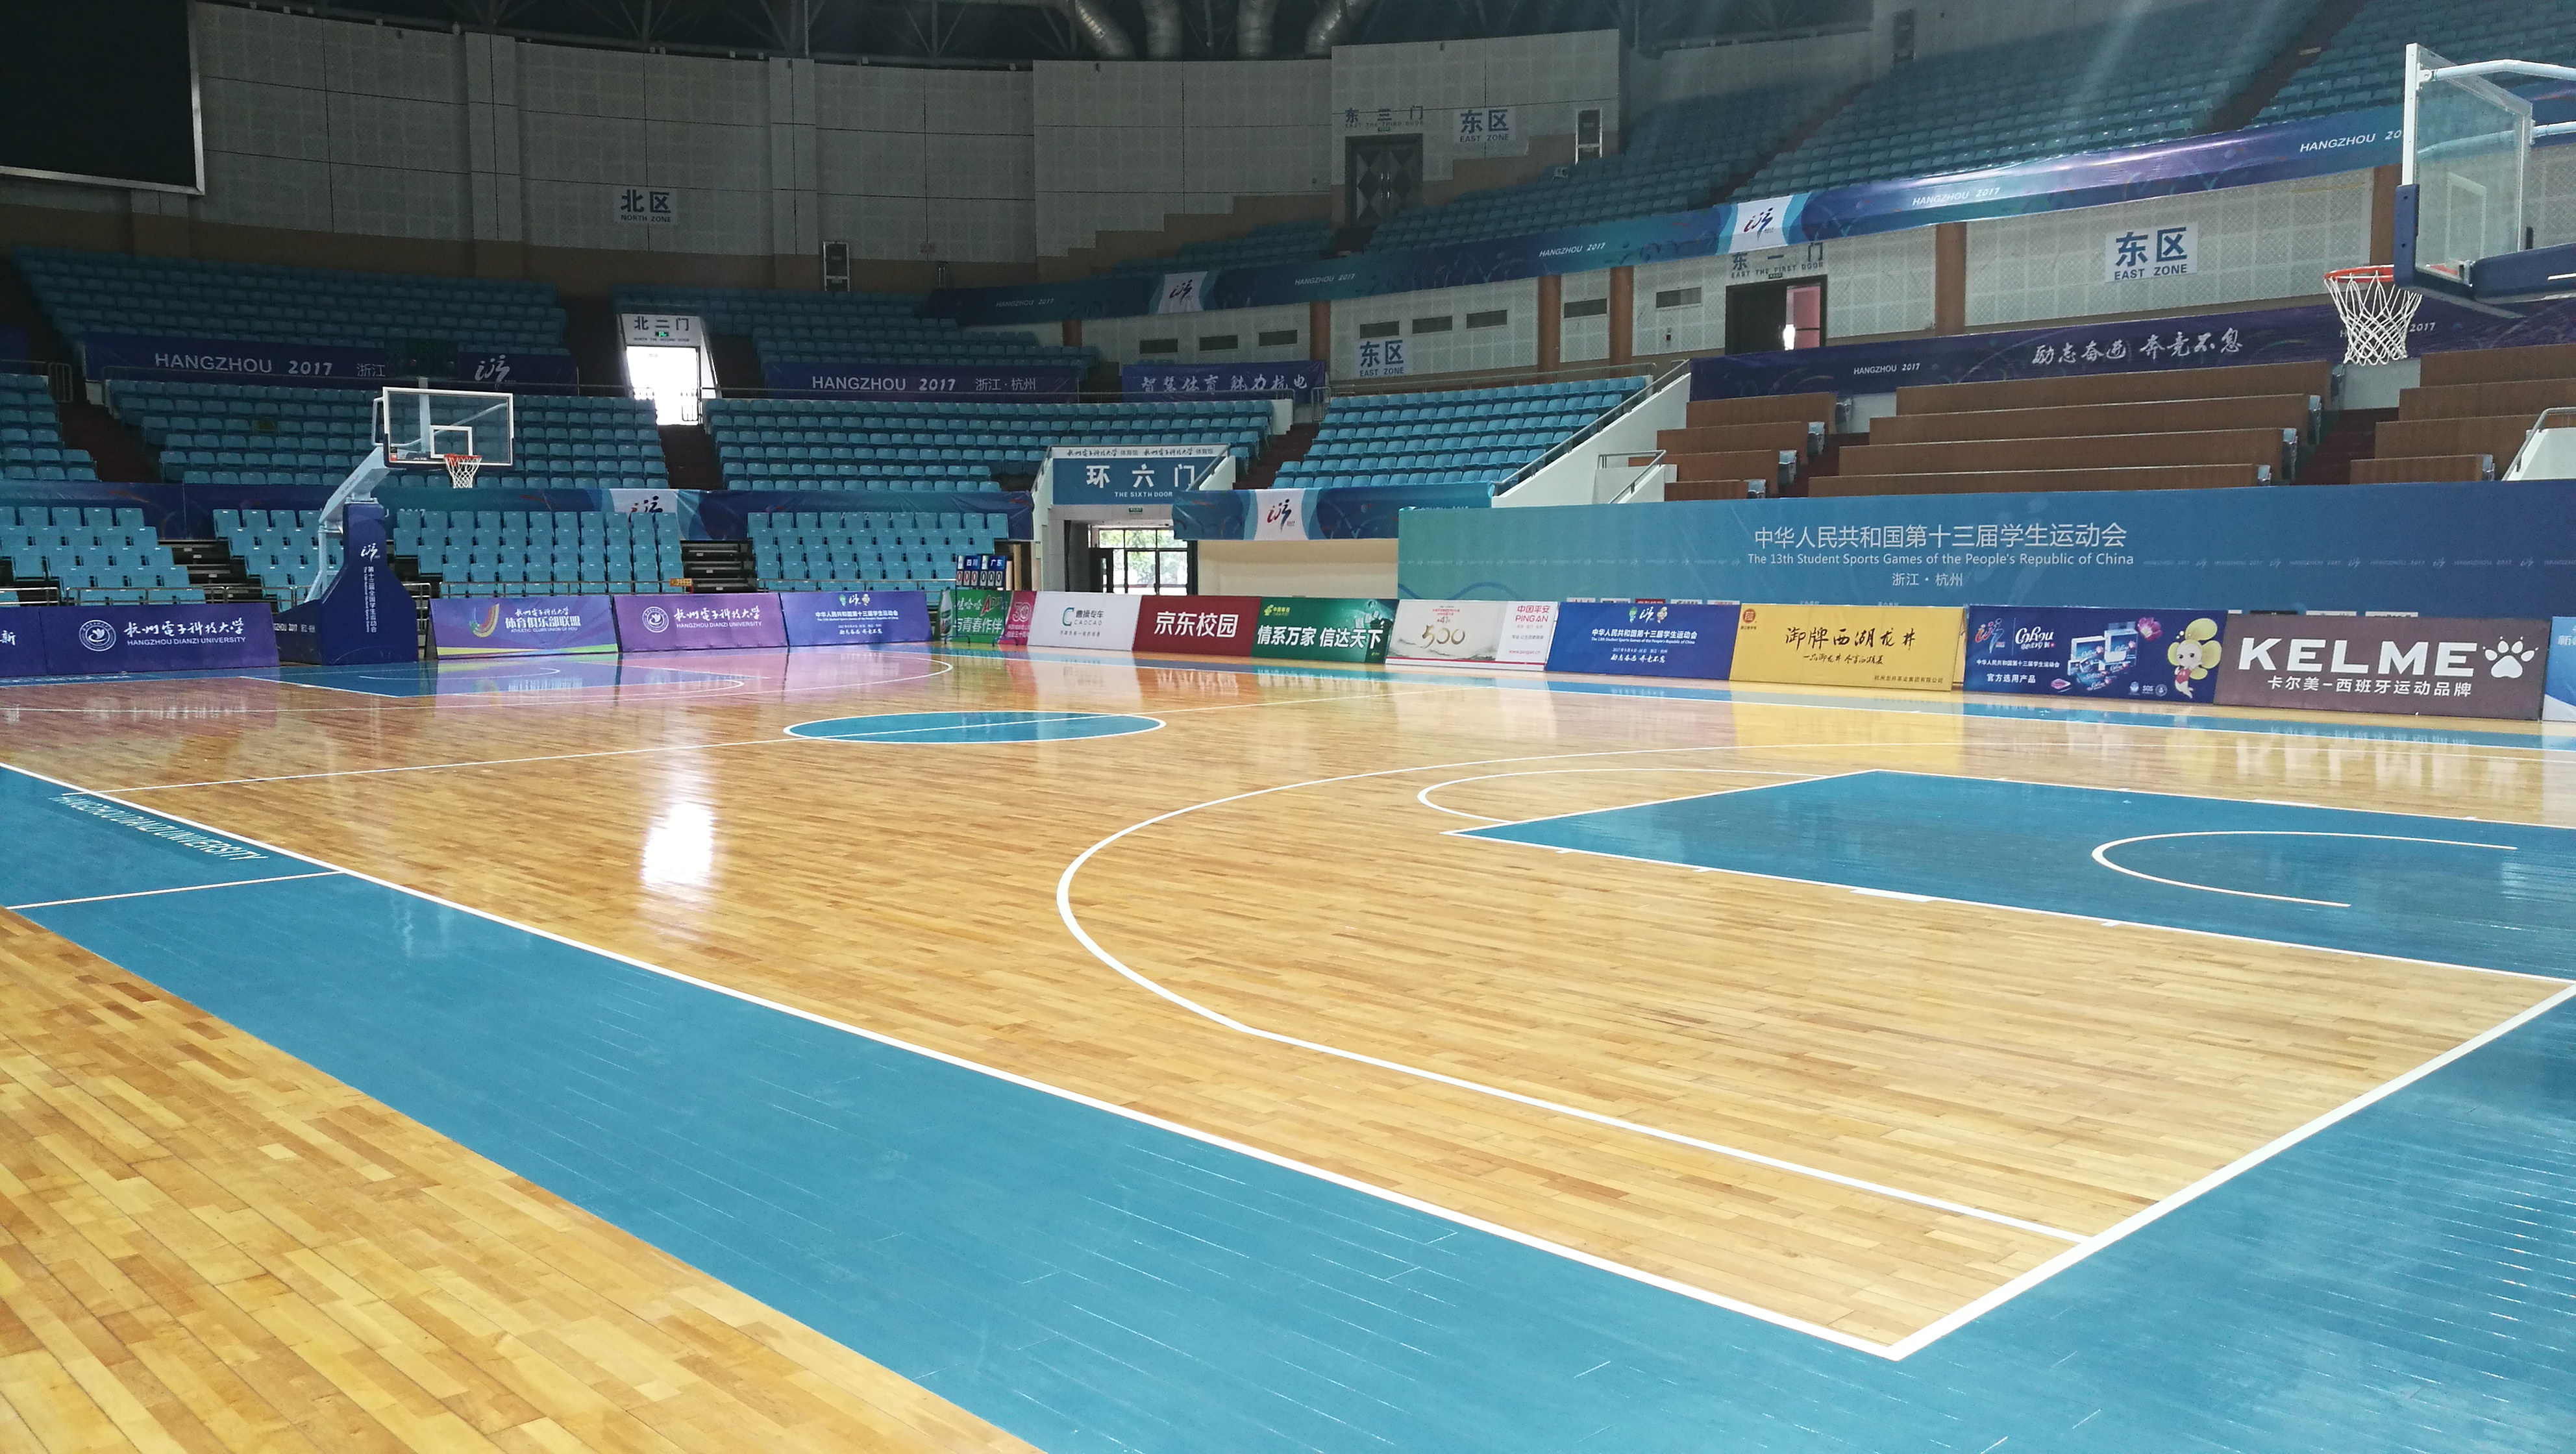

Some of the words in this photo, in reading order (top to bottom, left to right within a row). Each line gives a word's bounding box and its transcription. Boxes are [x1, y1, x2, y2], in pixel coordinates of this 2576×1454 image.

[1461, 109, 1509, 134] 东区
[2300, 133, 2376, 153] HANGZHOU
[621, 189, 671, 214] 北区
[1913, 191, 1969, 206] HANGZHOU
[1975, 187, 2000, 197] 2017
[1539, 245, 1583, 257] HANGZHOU
[1587, 242, 1605, 251] 2017
[2115, 227, 2188, 267] 东区
[1732, 242, 1823, 270] 东一门
[1295, 275, 1334, 286] HANGZHOU
[1338, 273, 1356, 282] 2017
[1731, 270, 1750, 278] EAST
[2114, 268, 2146, 280] EAST
[2153, 264, 2188, 276] ZONE
[995, 299, 1034, 308] HANGZHOU
[634, 315, 689, 331] 北二门
[2409, 322, 2435, 333] 2017
[1360, 339, 1404, 367] 东区
[155, 352, 273, 374] HANGZHOU
[288, 360, 332, 376] 2017
[1359, 369, 1378, 377] EAST
[1383, 367, 1404, 375] ZONE
[1853, 364, 1897, 375] HANGZHOU
[1901, 363, 1920, 371] 2017
[811, 376, 906, 391] HANGZHOU
[919, 378, 956, 391] 2017
[1086, 463, 1195, 488] 环六门
[1754, 521, 2128, 550] 中华人民共和国第十三届学生运动会
[1748, 553, 1766, 564] The
[1770, 553, 1794, 564] 13th
[1798, 553, 1839, 564] Student
[1843, 554, 1879, 567] Sports
[1883, 553, 1922, 564] Games
[1926, 552, 1938, 564] of
[1942, 552, 1961, 564] the
[1966, 553, 2015, 567] People's
[2020, 552, 2074, 567] Republic
[2079, 552, 2092, 564] of
[2096, 552, 2134, 565] China
[1076, 610, 1104, 618] 曹操专车
[1517, 605, 1551, 613] 中国平安
[505, 615, 581, 628] 体育俱乐部联盟
[952, 617, 1003, 634] 与青春作伴
[1154, 611, 1239, 638] 京东校园
[1257, 624, 1317, 647] 情系万家
[1319, 626, 1383, 649] 信达天下
[1591, 628, 1698, 639] 中华人民共和国第十三届学生运动会
[1976, 658, 2060, 668] 中华人民共和国第十三届学生运动会
[2238, 637, 2477, 677] KELME
[1987, 672, 2036, 684] 官方选用产品
